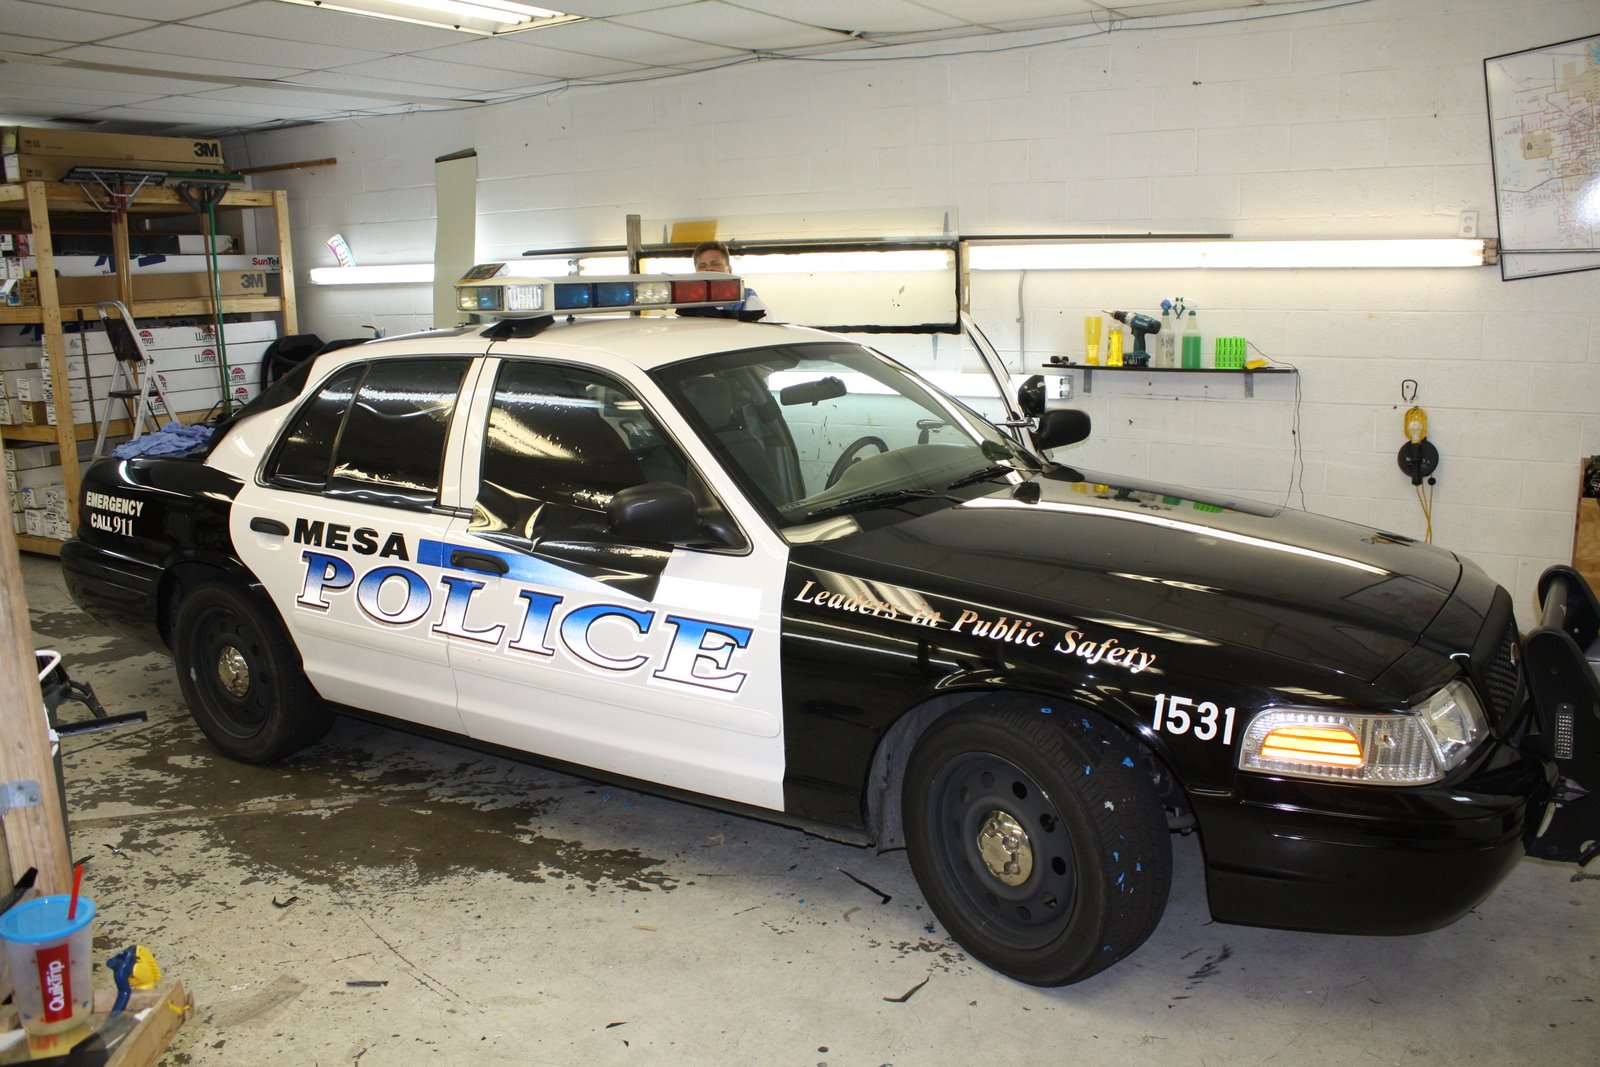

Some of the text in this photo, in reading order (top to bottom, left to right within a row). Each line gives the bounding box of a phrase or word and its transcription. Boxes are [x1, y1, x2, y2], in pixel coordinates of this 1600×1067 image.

[193, 142, 219, 157] 3M
[241, 273, 264, 288] 3M
[86, 491, 144, 517] EMERGENCY
[91, 512, 134, 537] CALL 911
[293, 517, 410, 561] MESA
[296, 549, 756, 695] POLICE
[794, 580, 1157, 674] Leaders in Public Safety
[1152, 692, 1236, 746] 1531
[46, 960, 65, 1012] QuikTrip
